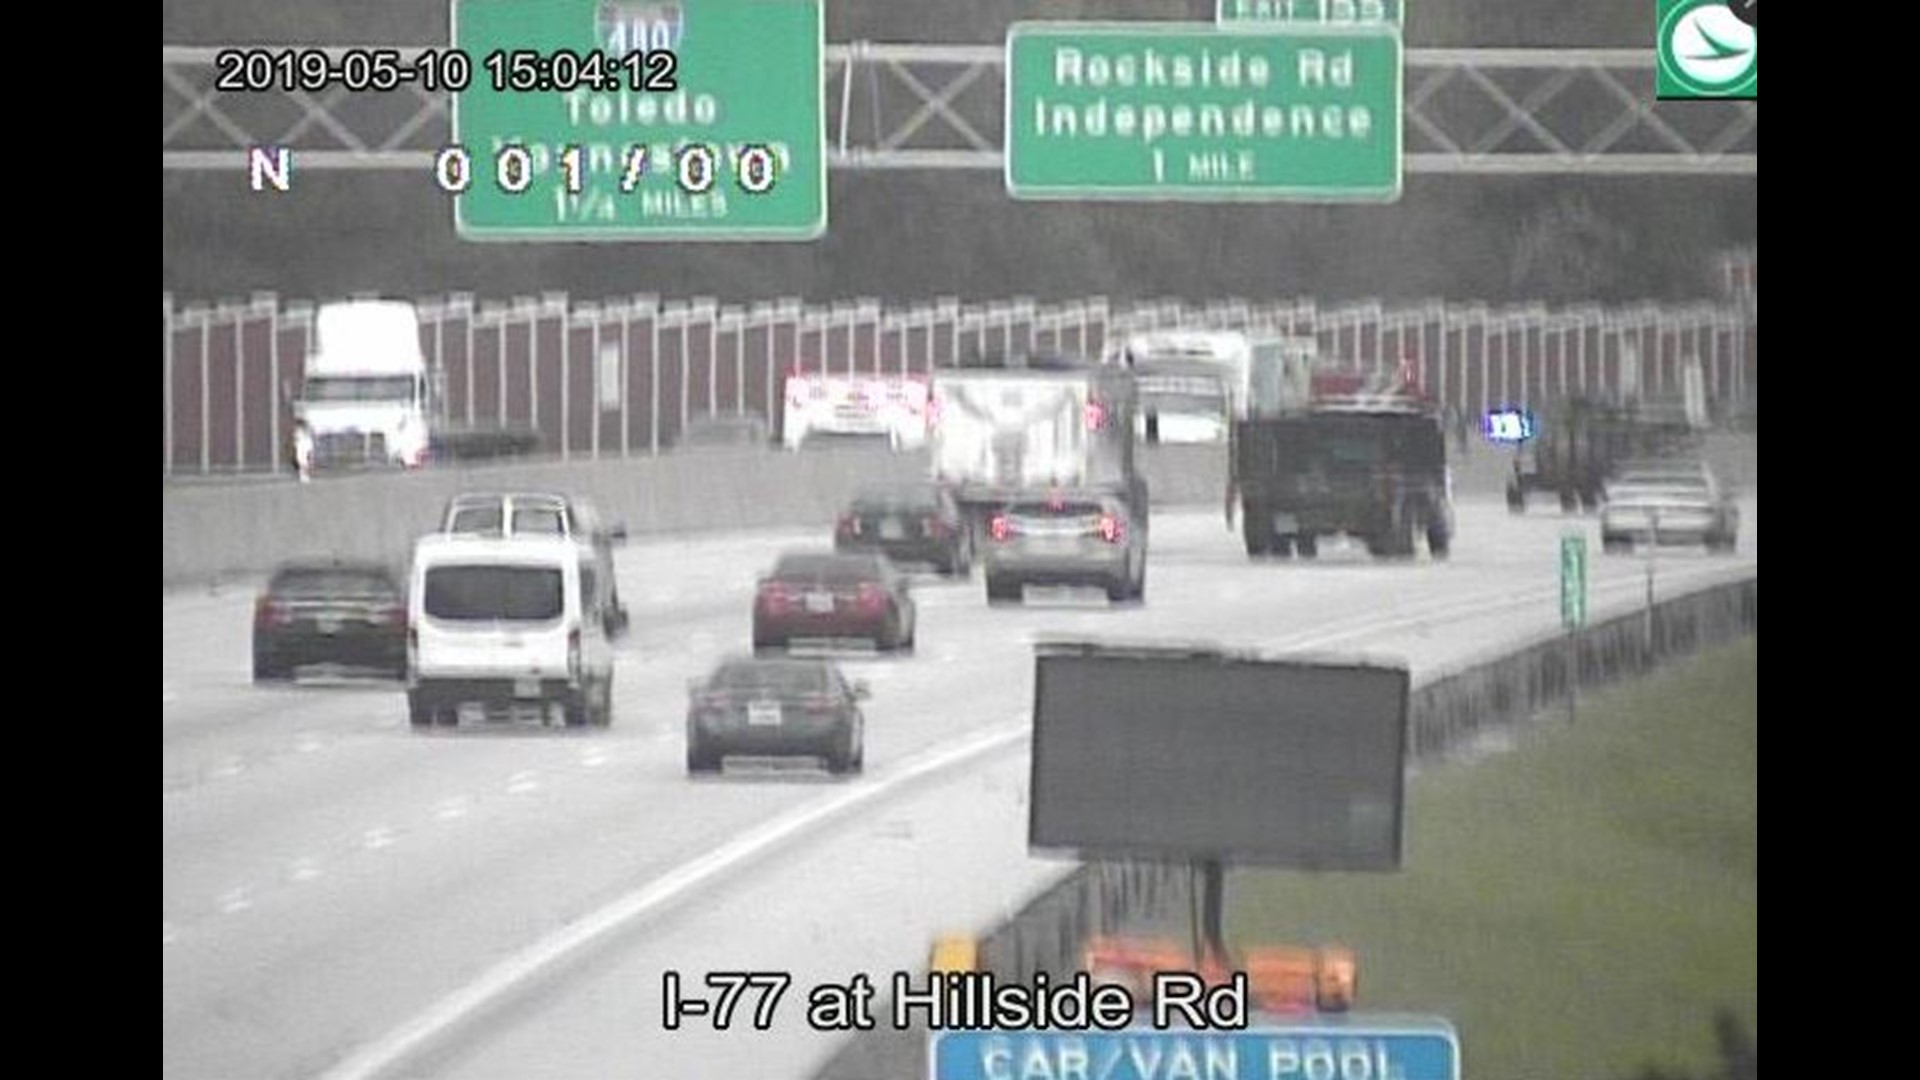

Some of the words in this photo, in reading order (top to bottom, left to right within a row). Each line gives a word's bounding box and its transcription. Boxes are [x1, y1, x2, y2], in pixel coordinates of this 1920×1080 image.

[1055, 48, 1269, 88] Rockside
[1298, 49, 1352, 88] Rd
[562, 90, 717, 125] Toledo
[1035, 97, 1372, 144] Independence
[1153, 148, 1165, 183] 1
[1188, 153, 1253, 181] MILE
[641, 187, 729, 219] MILES
[982, 1037, 1239, 1080] CAR/VAN
[1268, 1038, 1400, 1080] POOL
